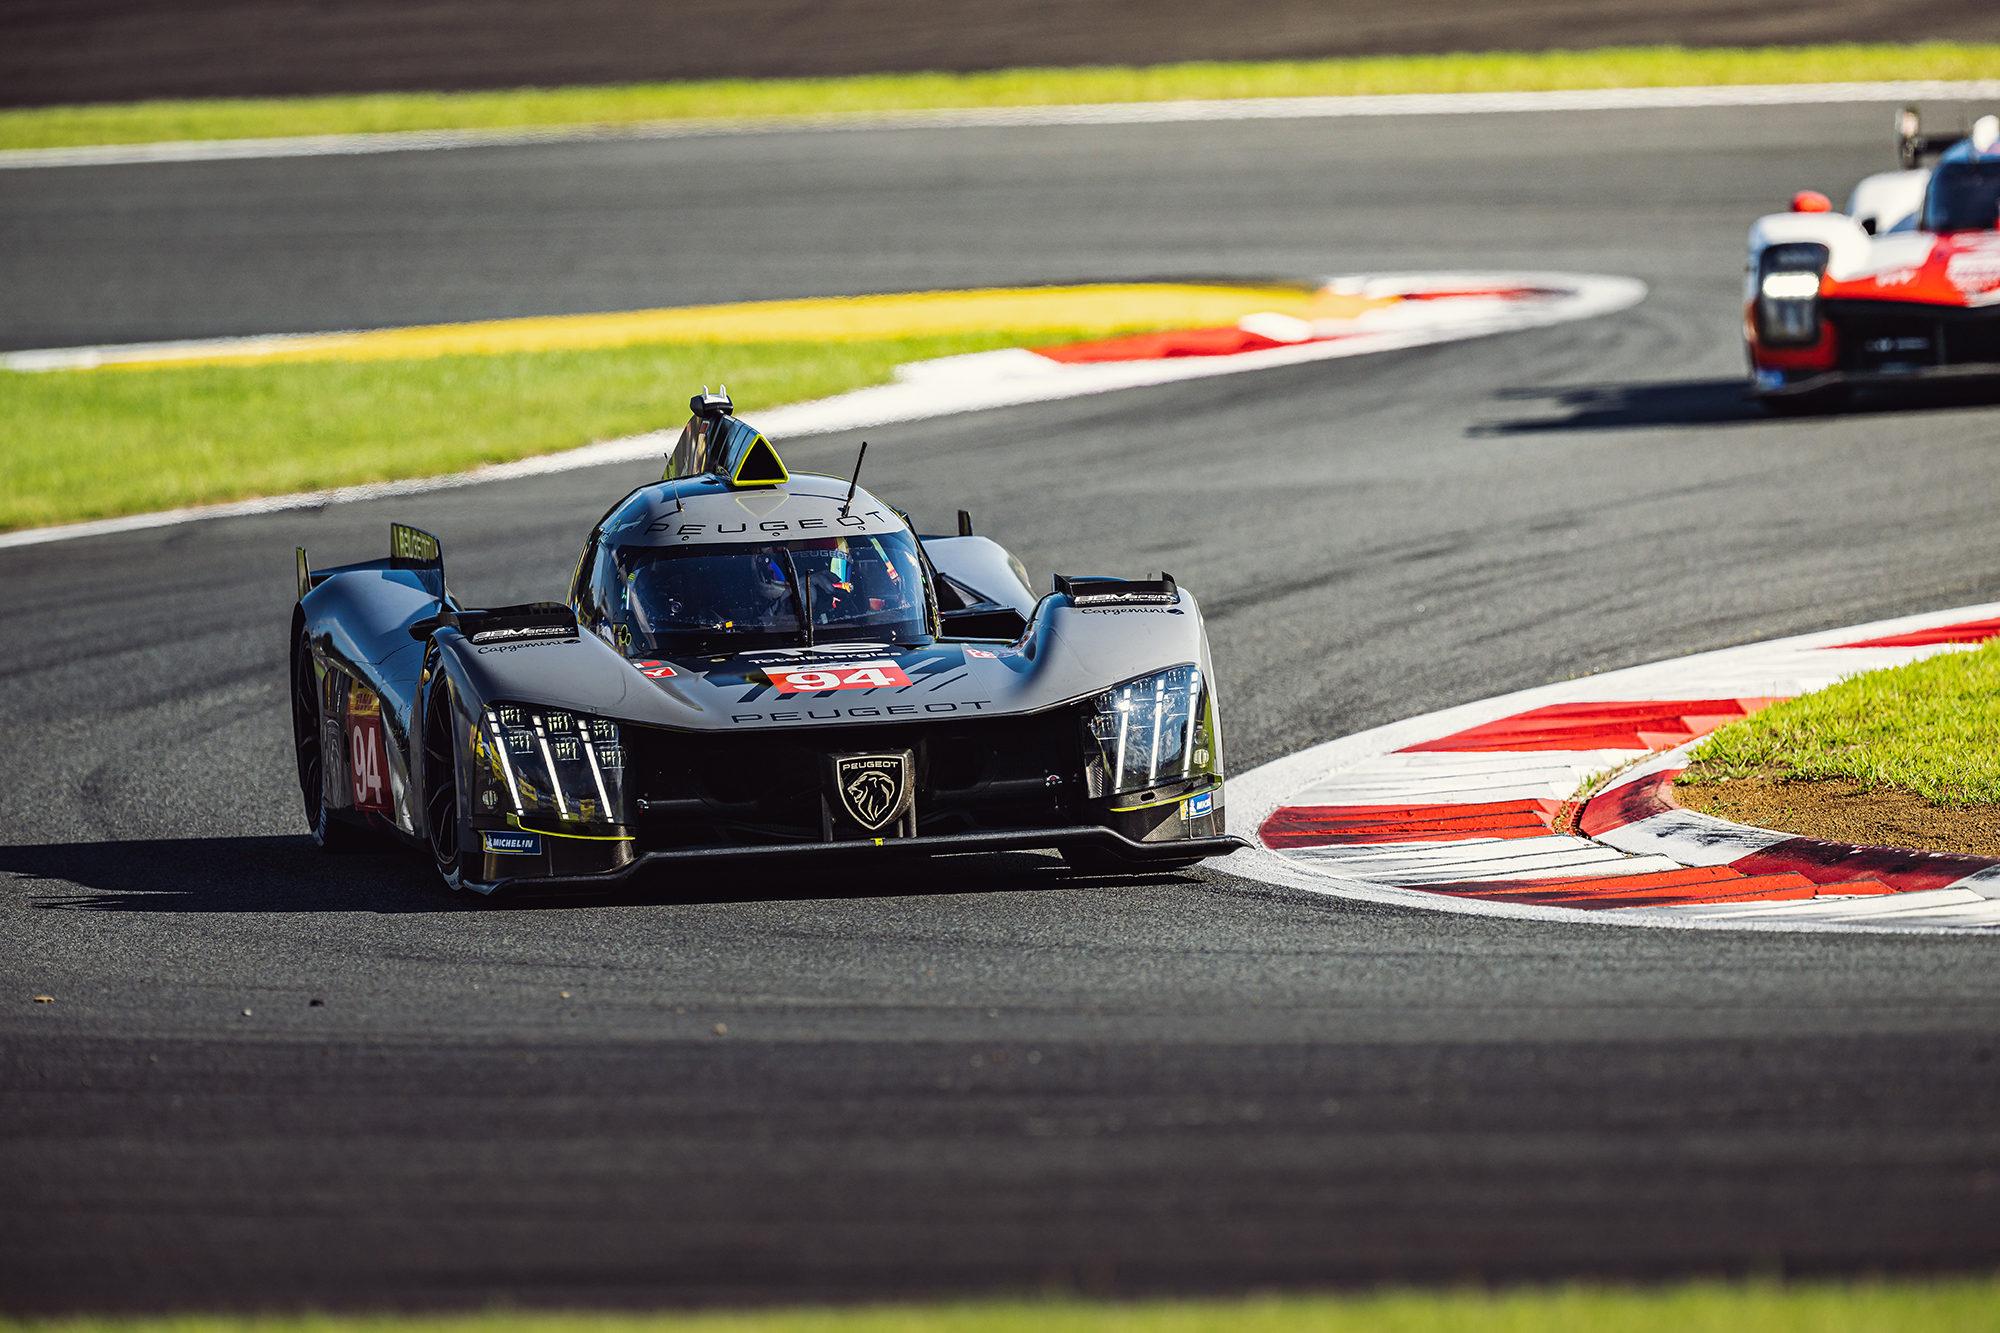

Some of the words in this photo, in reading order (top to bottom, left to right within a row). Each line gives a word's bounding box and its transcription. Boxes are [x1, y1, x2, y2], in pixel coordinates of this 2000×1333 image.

[643, 510, 885, 536] PEUGEOT
[791, 550, 849, 560] PEUGEOT
[1081, 607, 1166, 615] Capgemini
[478, 640, 561, 654] Capgemini
[748, 651, 902, 665] TotalEnergies
[785, 668, 895, 690] 94
[731, 700, 991, 723] PEUGEOT
[353, 725, 383, 804] 94
[842, 760, 899, 771] PEUGEOT
[492, 837, 534, 848] MICHELIN
